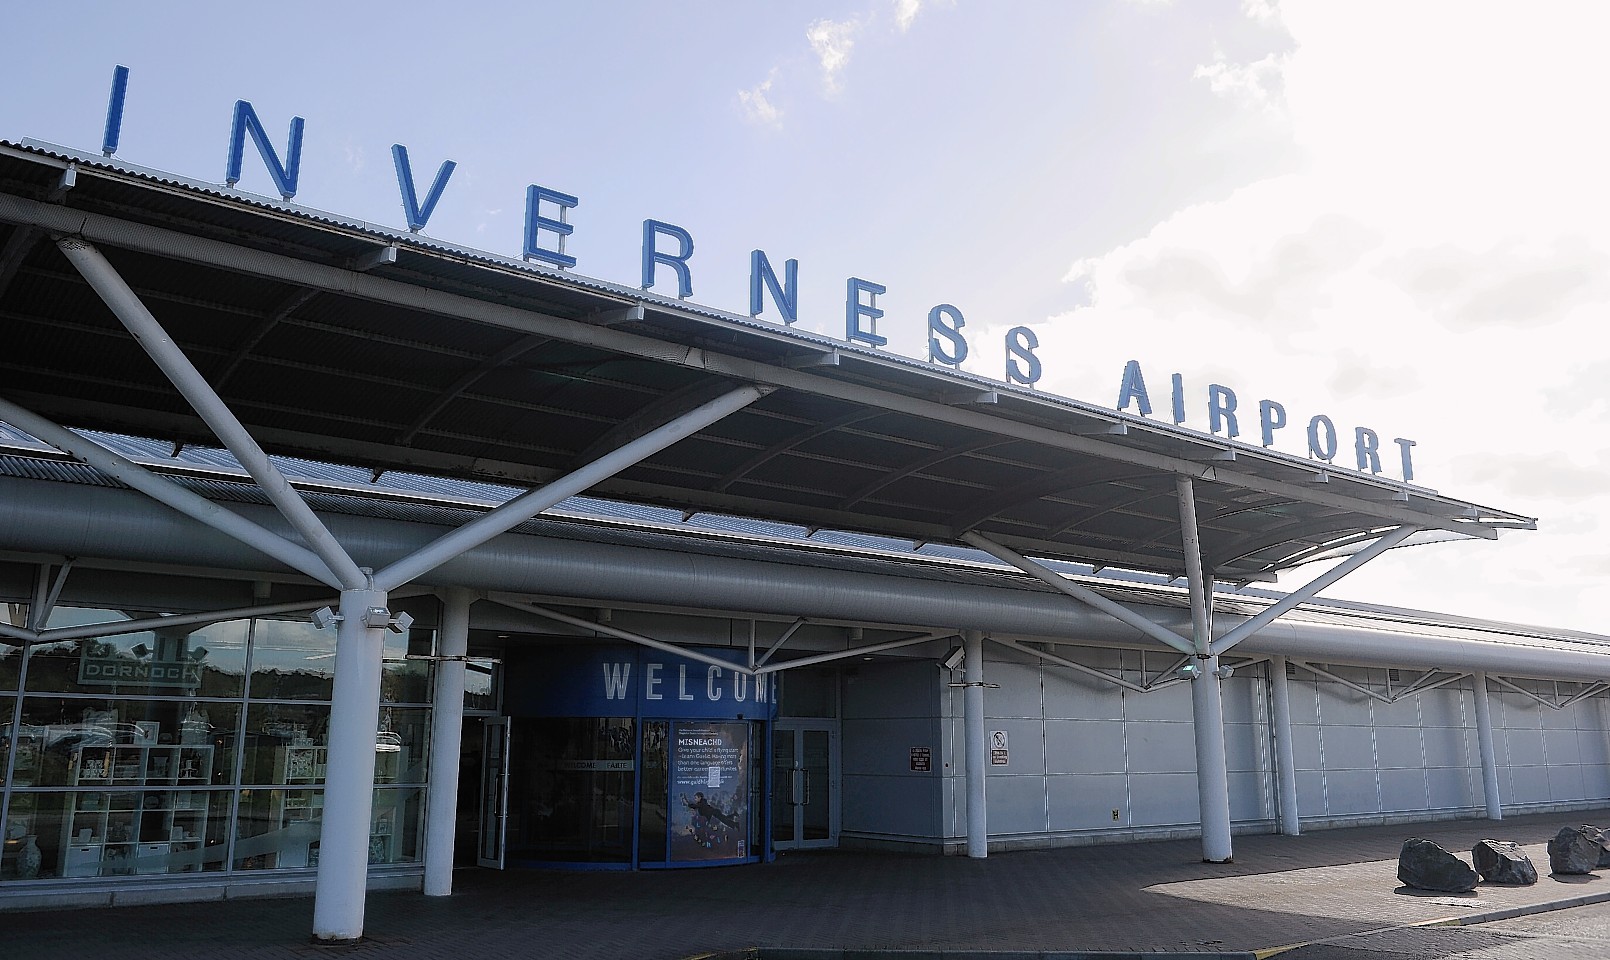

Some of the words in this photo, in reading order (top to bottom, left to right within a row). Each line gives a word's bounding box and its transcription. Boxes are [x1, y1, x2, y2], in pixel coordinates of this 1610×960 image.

[102, 64, 1042, 387] INVERNESS
[1117, 359, 1418, 481] AIRPORT
[86, 664, 198, 681] DORNOCH
[602, 662, 778, 704] WELCOME
